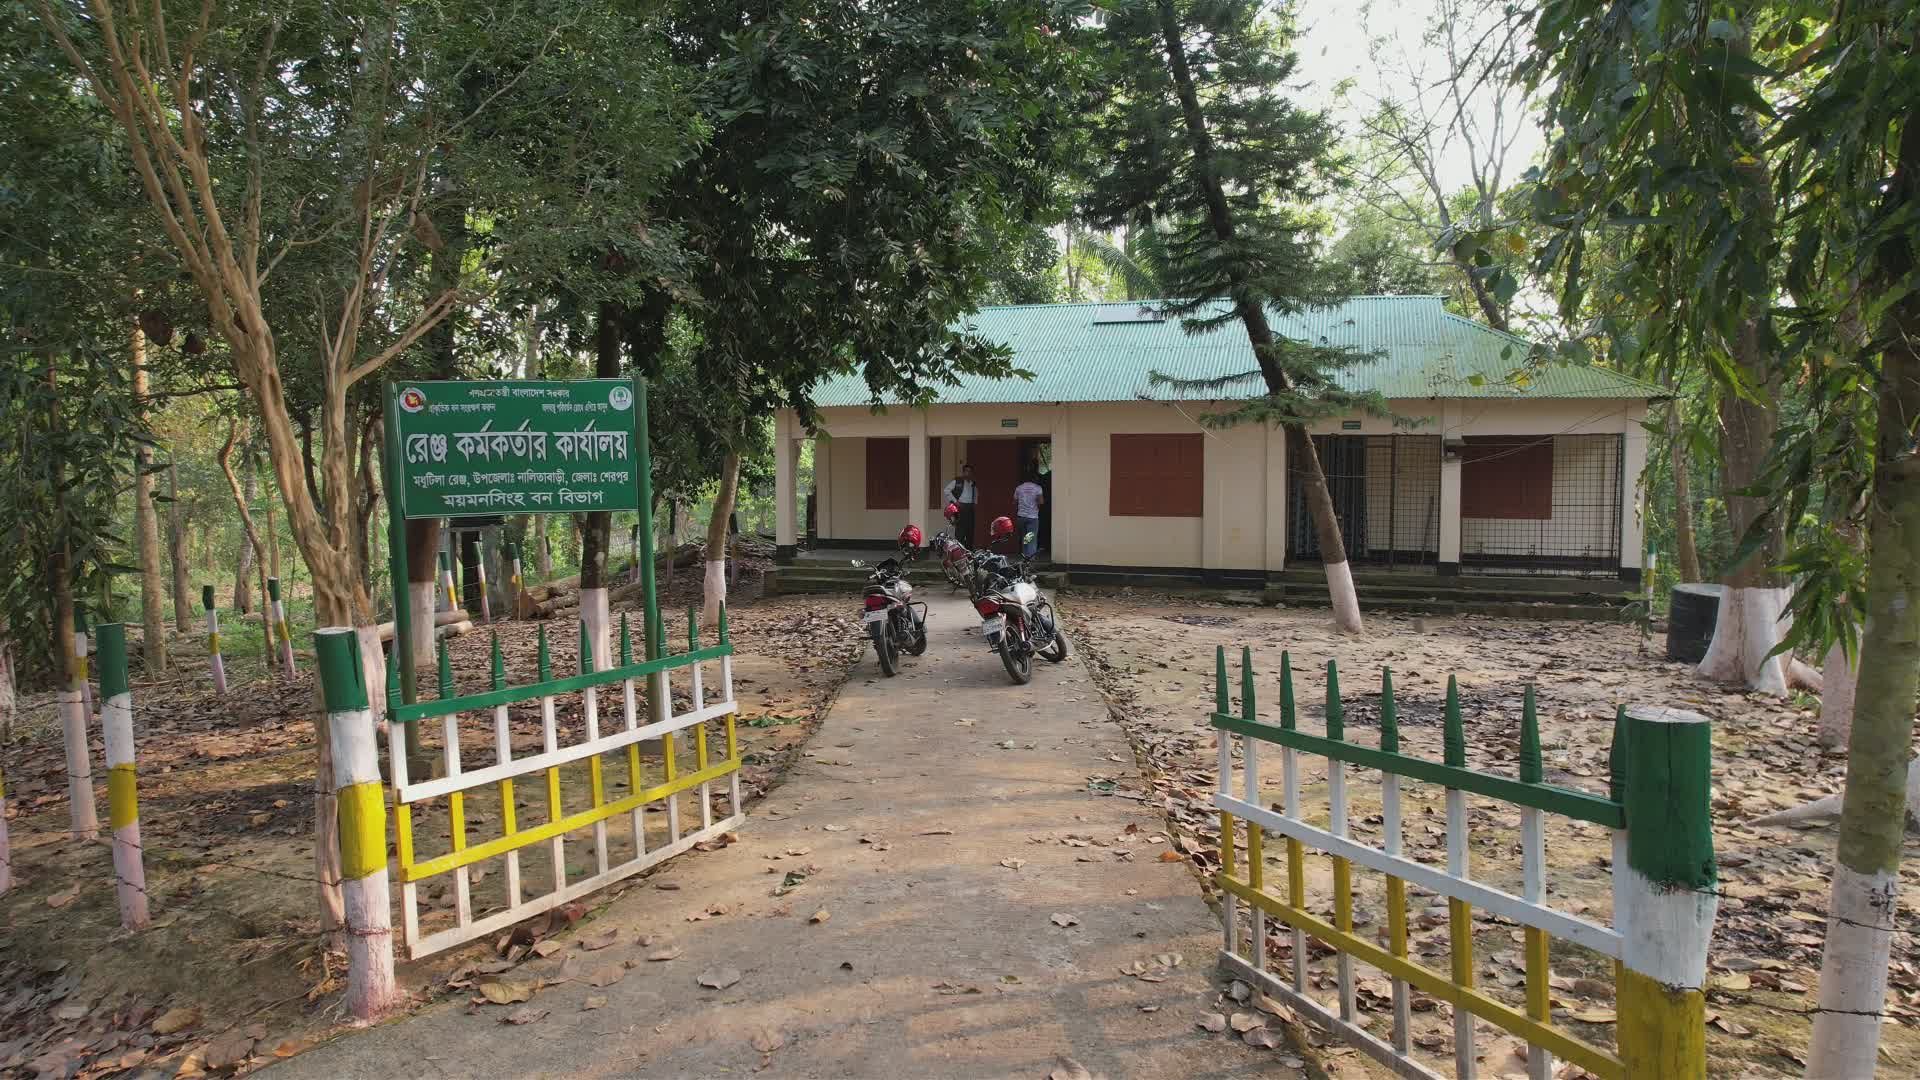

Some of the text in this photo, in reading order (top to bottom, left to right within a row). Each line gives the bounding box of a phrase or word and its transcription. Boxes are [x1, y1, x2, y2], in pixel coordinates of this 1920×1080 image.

[511, 387, 545, 398] বাংলাদেশ
[406, 419, 628, 464] রেঞ্জ কর্মকর্তার কার্যালয়
[413, 468, 629, 488] মধুটিলা রেঞ্জ, উপজেলাঃ নালিতাবাড়ী, জেলাঃ শেরপুর
[441, 487, 604, 508] ময়মনসিংহ বন বিভাগ
